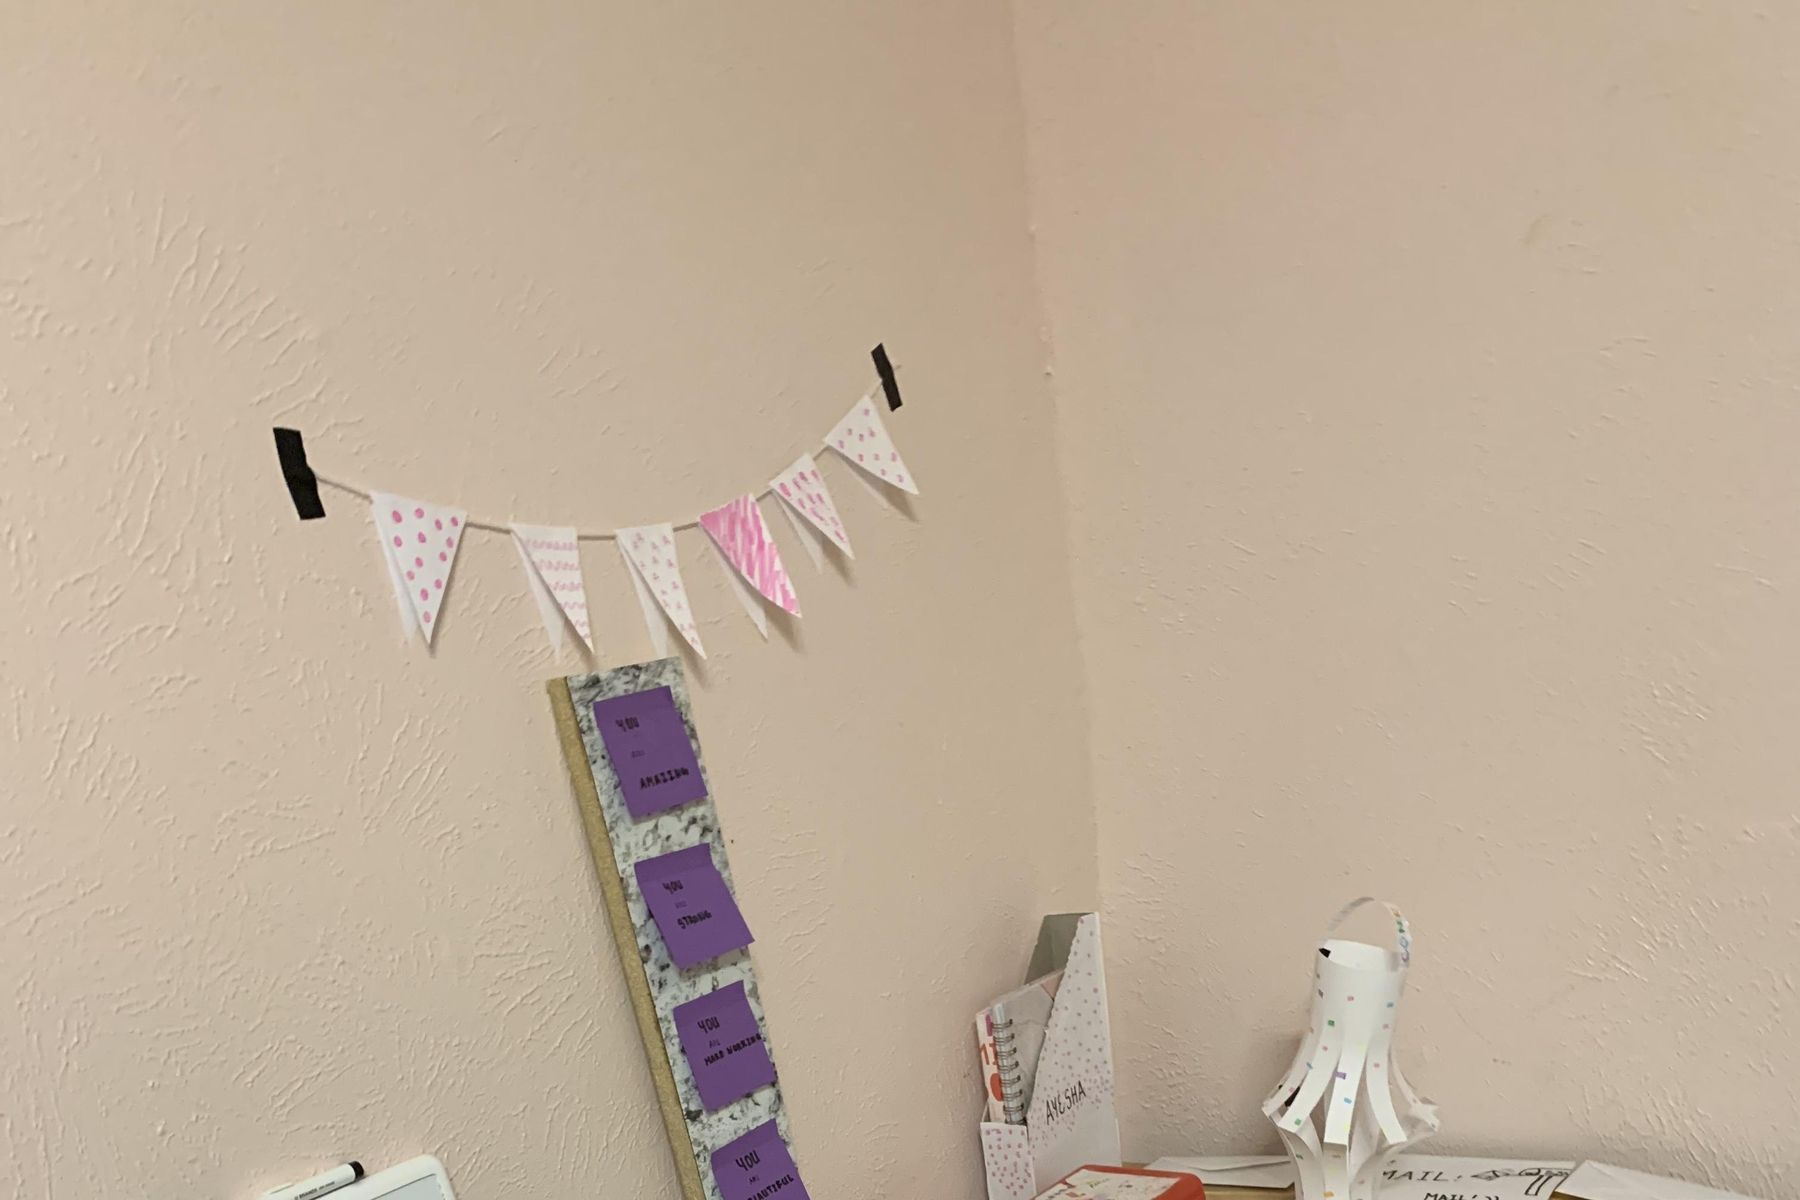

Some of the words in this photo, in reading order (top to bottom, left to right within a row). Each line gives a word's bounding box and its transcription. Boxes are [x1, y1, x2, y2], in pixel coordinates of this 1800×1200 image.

[615, 716, 640, 732] YOU
[662, 879, 683, 895] YOU
[697, 1016, 720, 1034] YOU
[1045, 1080, 1087, 1126] AYESHA
[735, 1150, 761, 1171] YOU
